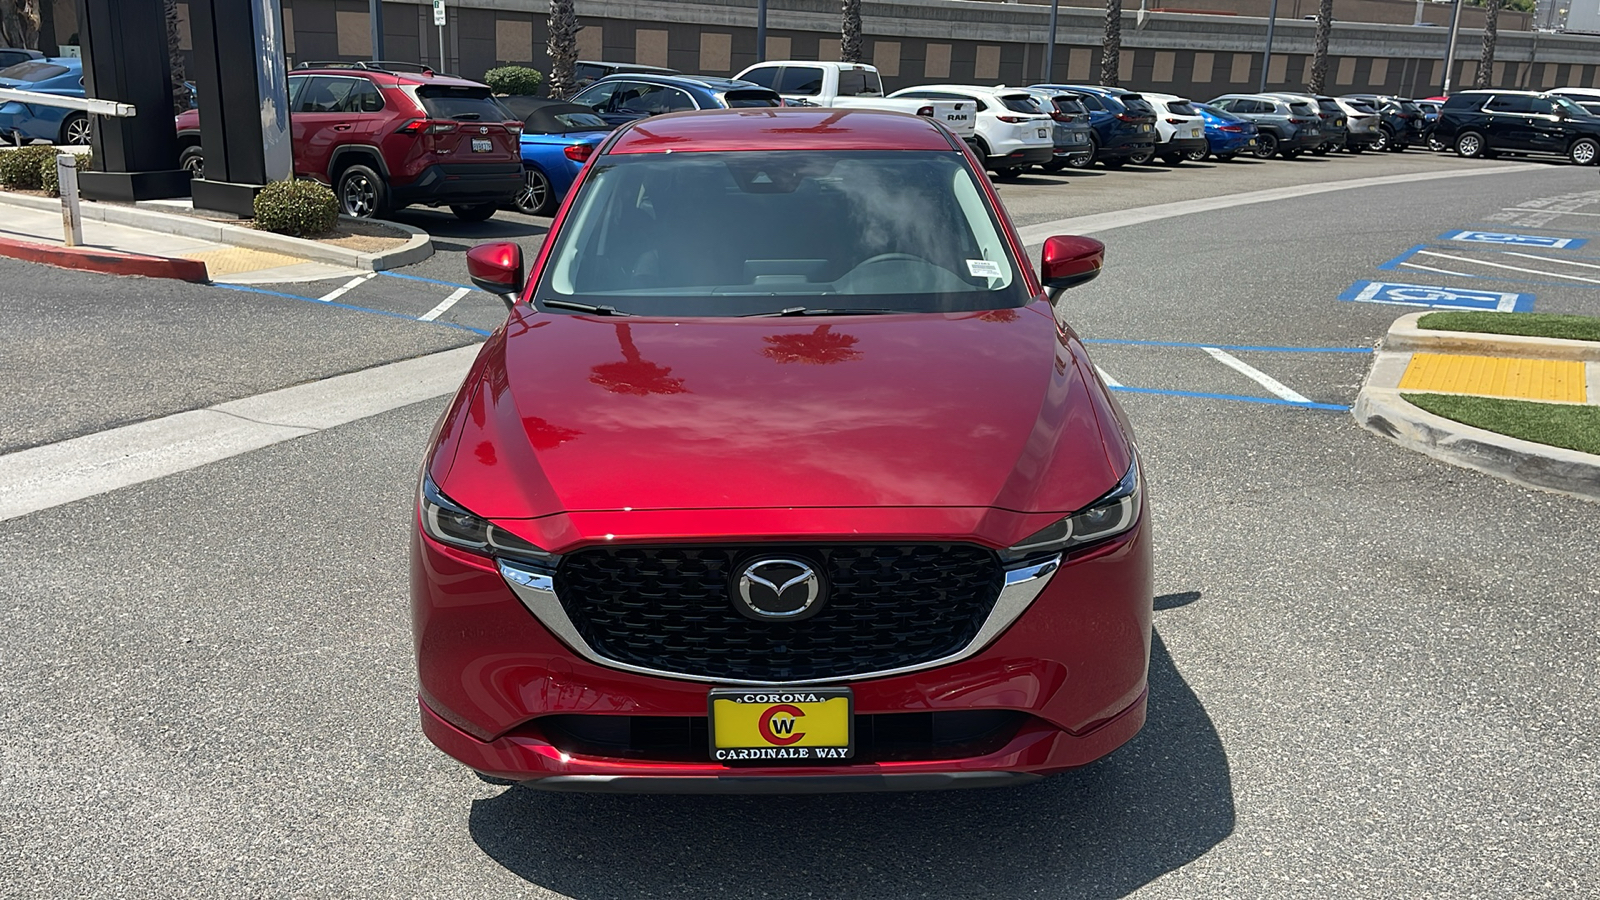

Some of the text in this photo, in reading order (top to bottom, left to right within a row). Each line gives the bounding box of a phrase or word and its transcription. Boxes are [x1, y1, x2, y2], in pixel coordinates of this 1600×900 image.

[743, 693, 819, 703] CORONA
[716, 748, 849, 760] CARDINALE WAY
